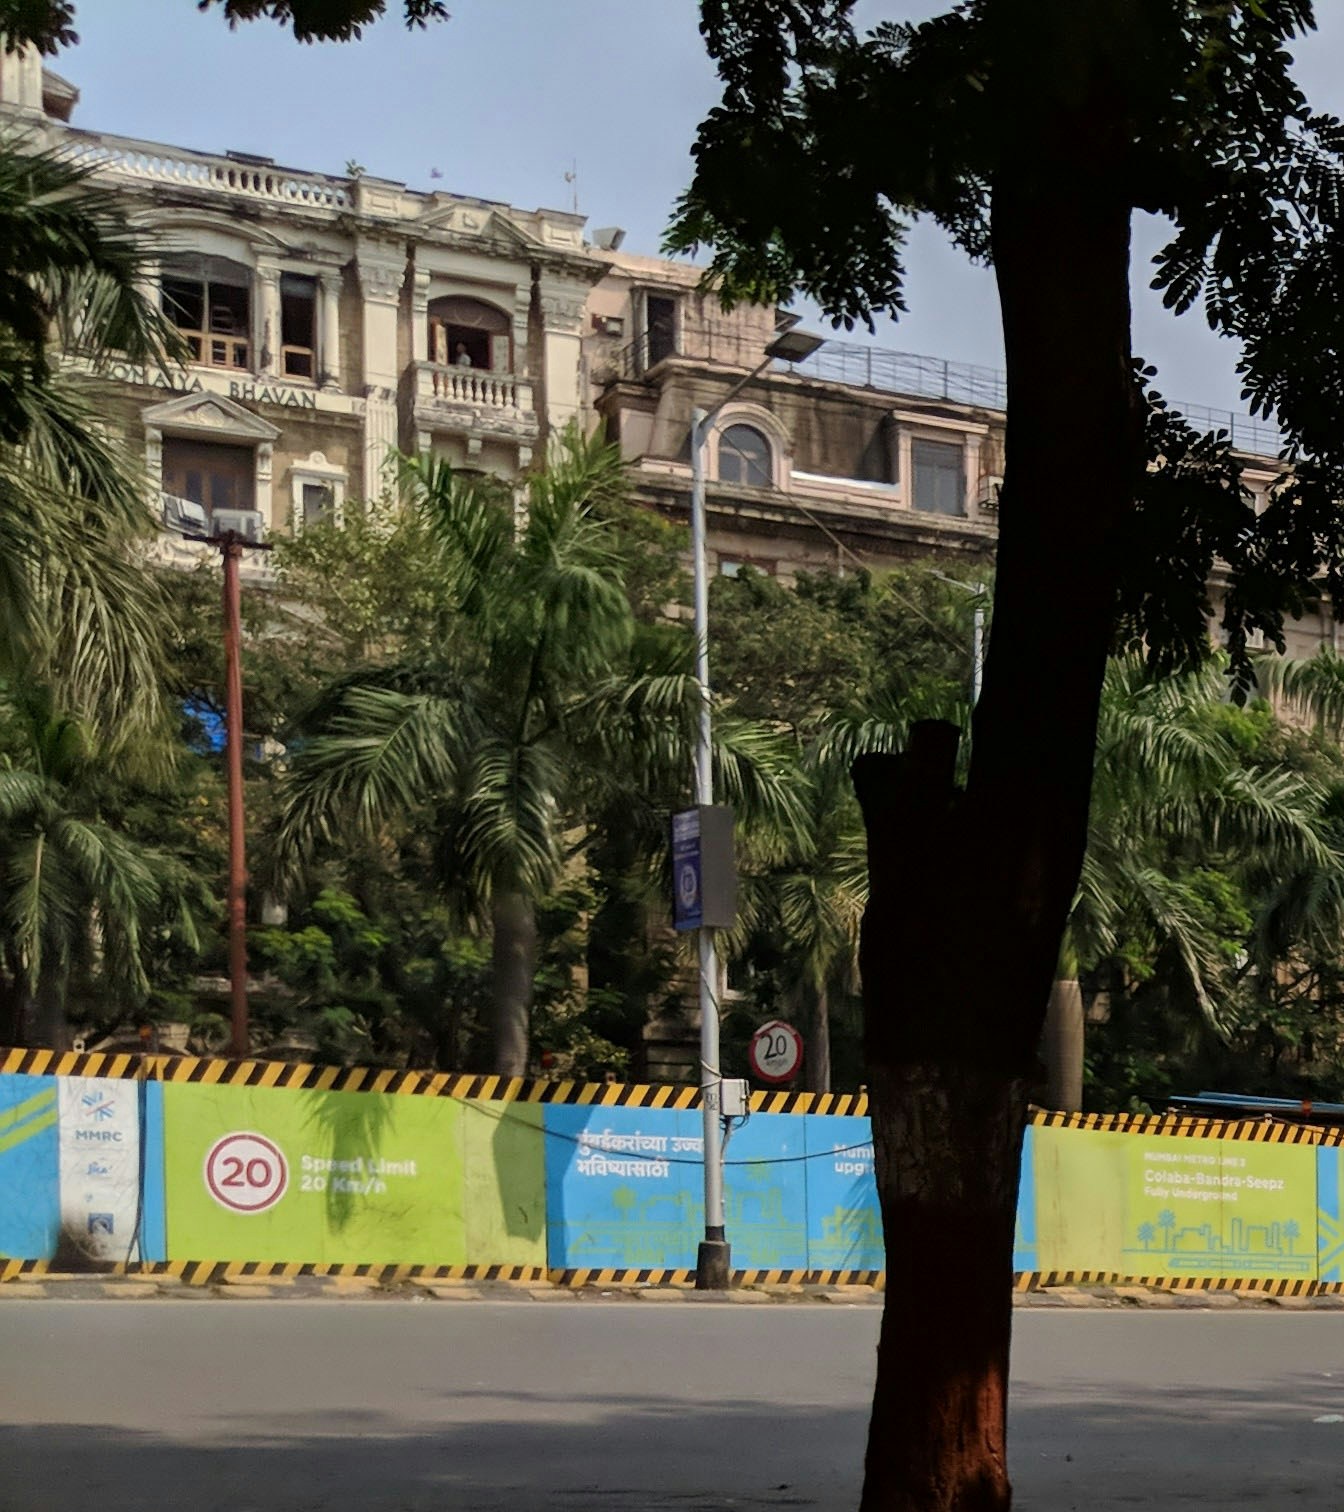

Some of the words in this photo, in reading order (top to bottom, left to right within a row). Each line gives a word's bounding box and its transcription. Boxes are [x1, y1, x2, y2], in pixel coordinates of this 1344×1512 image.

[230, 380, 317, 409] BHAVAN
[760, 1034, 787, 1060] 20
[75, 1130, 122, 1142] MMRC
[222, 1156, 273, 1188] 20
[301, 1154, 363, 1173] Speed
[366, 1156, 417, 1176] Limit
[301, 1175, 327, 1191] 20
[332, 1176, 387, 1195] Km/h
